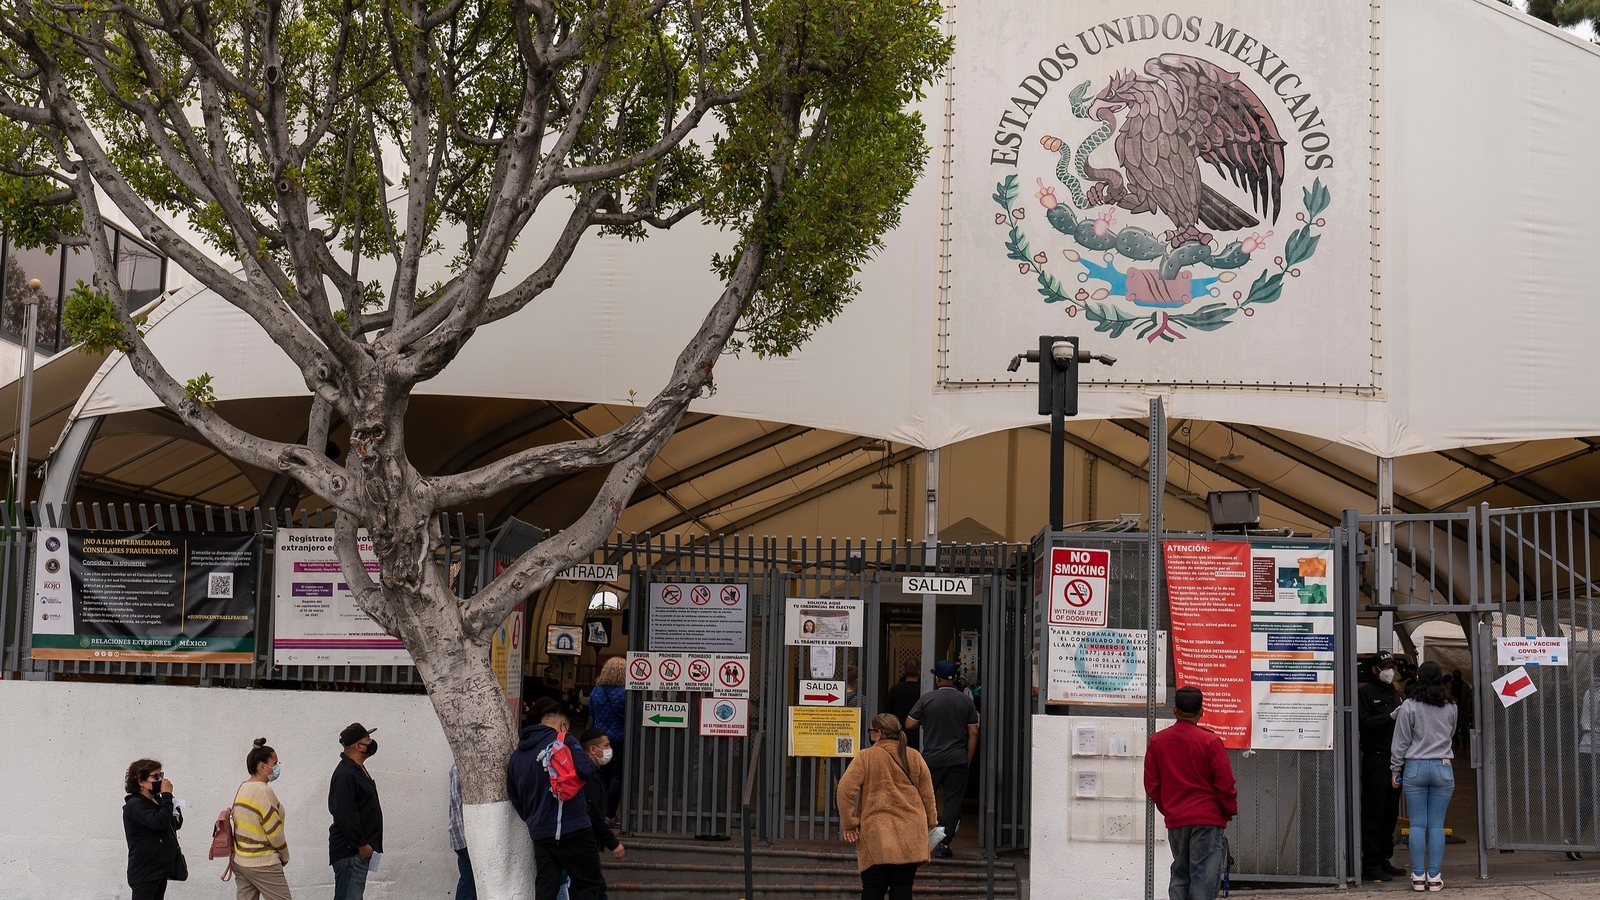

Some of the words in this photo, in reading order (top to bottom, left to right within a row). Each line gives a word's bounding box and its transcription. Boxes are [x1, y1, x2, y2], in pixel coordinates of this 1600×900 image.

[990, 43, 1080, 168] ESTADOS
[1075, 13, 1203, 56] UNIDOS
[1205, 21, 1334, 171] MEXICANOS
[289, 535, 332, 543] Regístrate
[1070, 551, 1090, 563] NO
[1055, 564, 1105, 576] SMOKING
[44, 582, 60, 590] ROJO
[908, 579, 966, 592] SALIDA
[645, 704, 686, 712] ENTRADA
